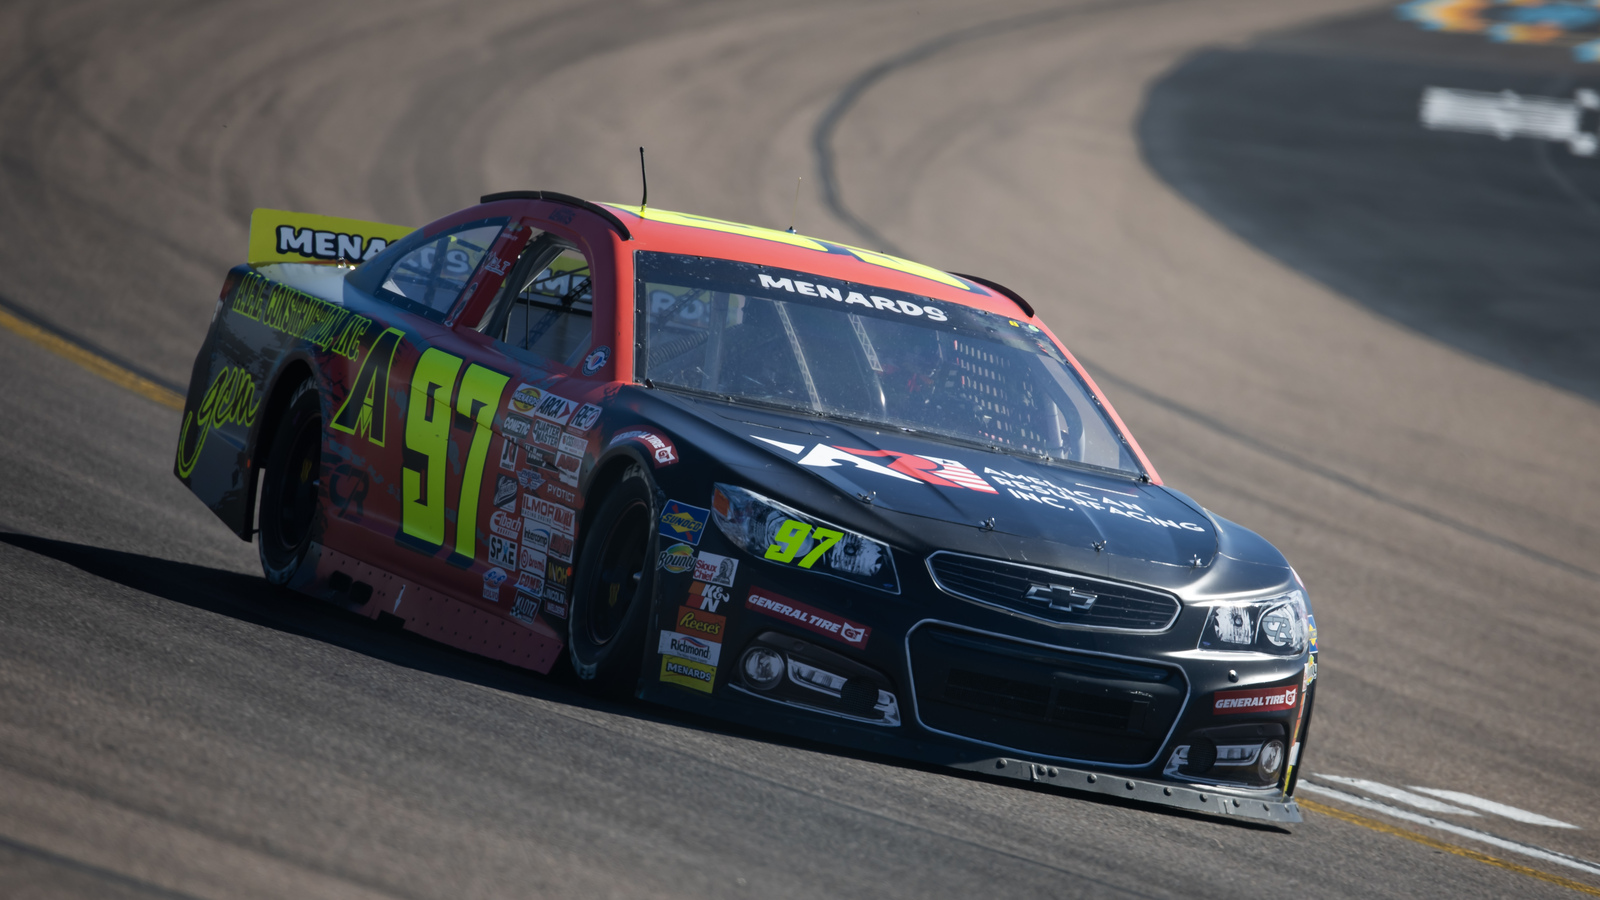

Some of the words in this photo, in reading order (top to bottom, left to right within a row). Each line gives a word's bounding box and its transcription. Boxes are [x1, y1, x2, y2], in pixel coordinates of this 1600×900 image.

[757, 272, 949, 324] MENARDS
[537, 395, 565, 418] ARCA
[503, 416, 531, 436] COMETIC
[533, 419, 561, 437] QUARTER
[536, 430, 559, 448] MASTER
[402, 347, 511, 561] 97
[991, 475, 1206, 533] RESURFACING
[1006, 487, 1075, 512] INC.
[489, 510, 522, 534] Eibach
[662, 513, 702, 532] SUNOCO
[524, 527, 548, 546] Intercomp
[764, 519, 844, 569] 97
[656, 550, 698, 572] Bounty
[695, 559, 717, 573] Sioux
[693, 569, 714, 581] Chief
[515, 595, 538, 617] KLOTZ
[543, 586, 566, 605] LINCOLN
[748, 593, 808, 623] GENERAL
[804, 612, 842, 634] TIRE
[670, 638, 710, 659] Richmond
[666, 662, 712, 682] MENARDS
[1214, 696, 1264, 709] GENERAL
[1264, 694, 1286, 706] TIRE
